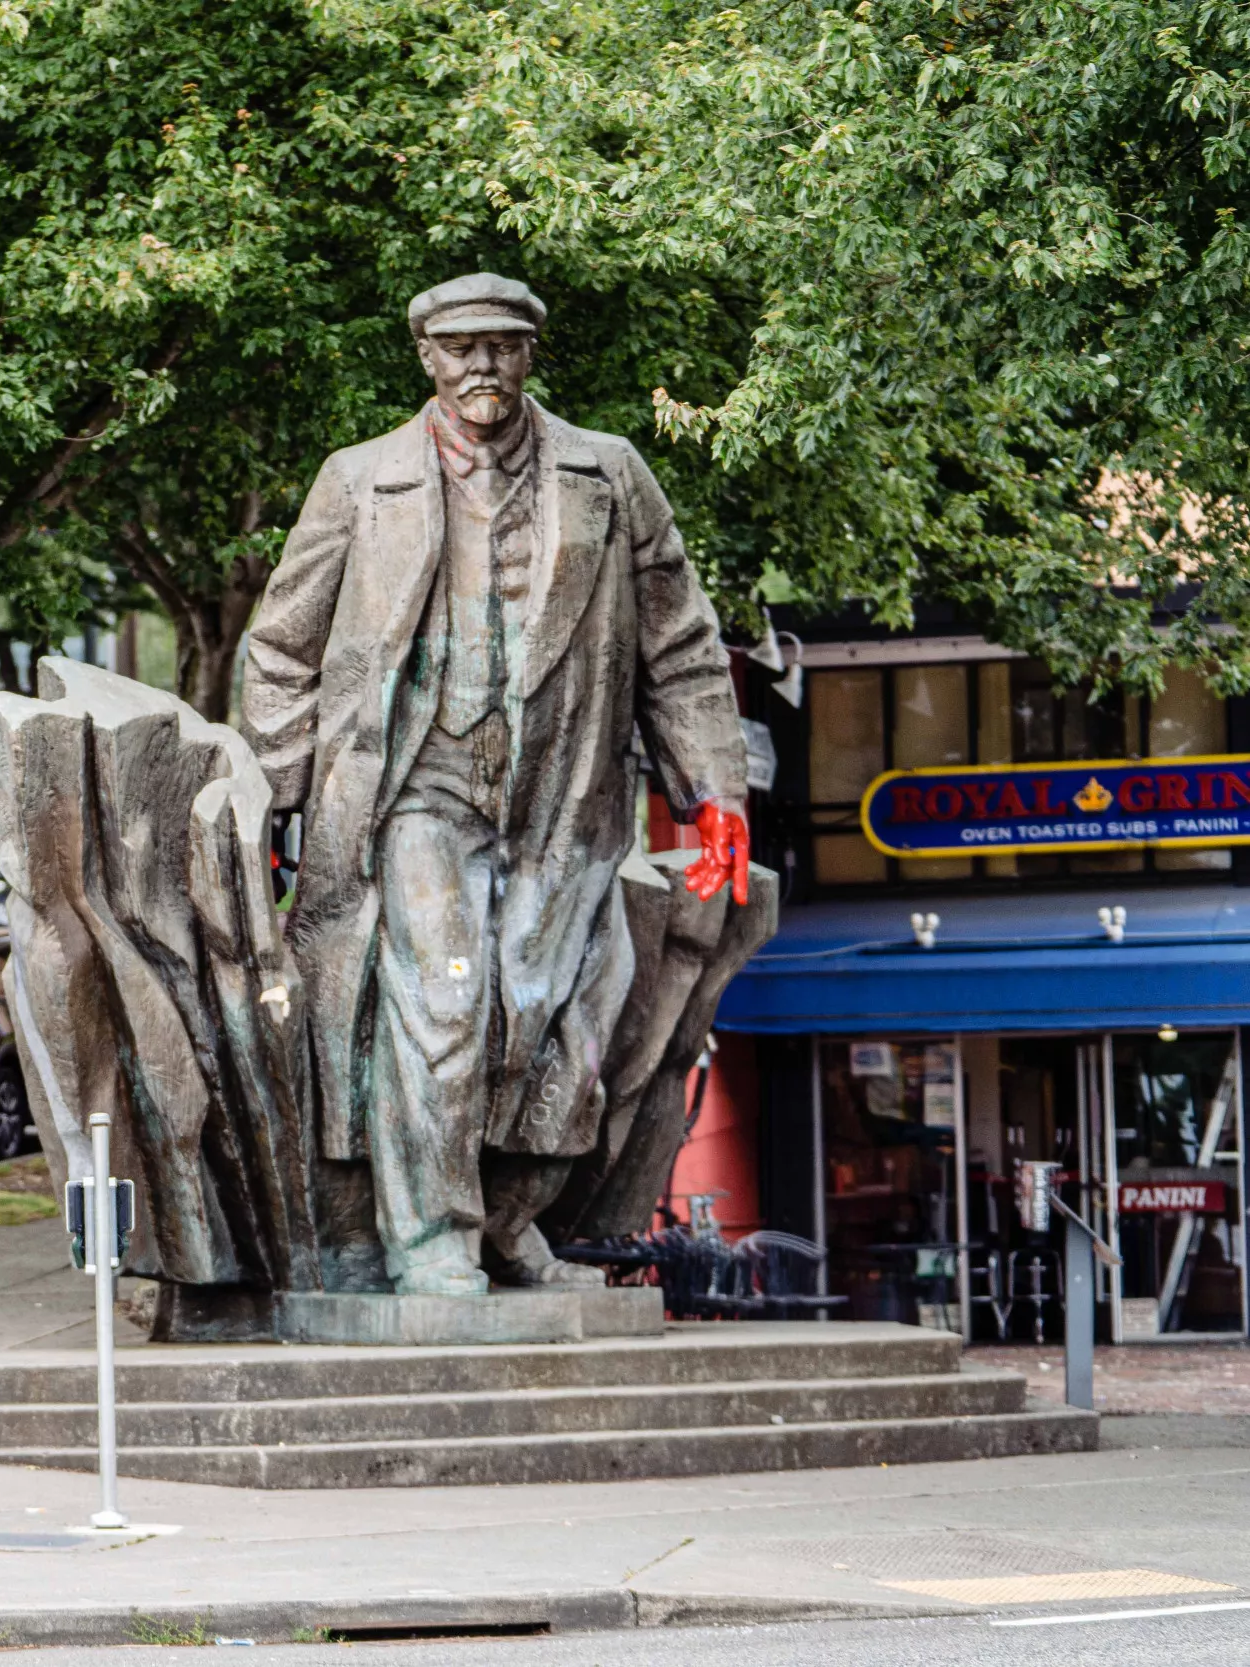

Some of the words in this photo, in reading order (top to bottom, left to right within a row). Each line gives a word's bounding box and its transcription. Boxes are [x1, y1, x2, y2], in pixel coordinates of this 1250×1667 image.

[890, 780, 1067, 823] ROYAL
[960, 826, 1012, 843] OVEN
[1017, 822, 1102, 839] TOASTED
[1107, 820, 1158, 836] SUBS
[1173, 817, 1239, 833] PANINI
[1122, 1187, 1207, 1208] PANINI
